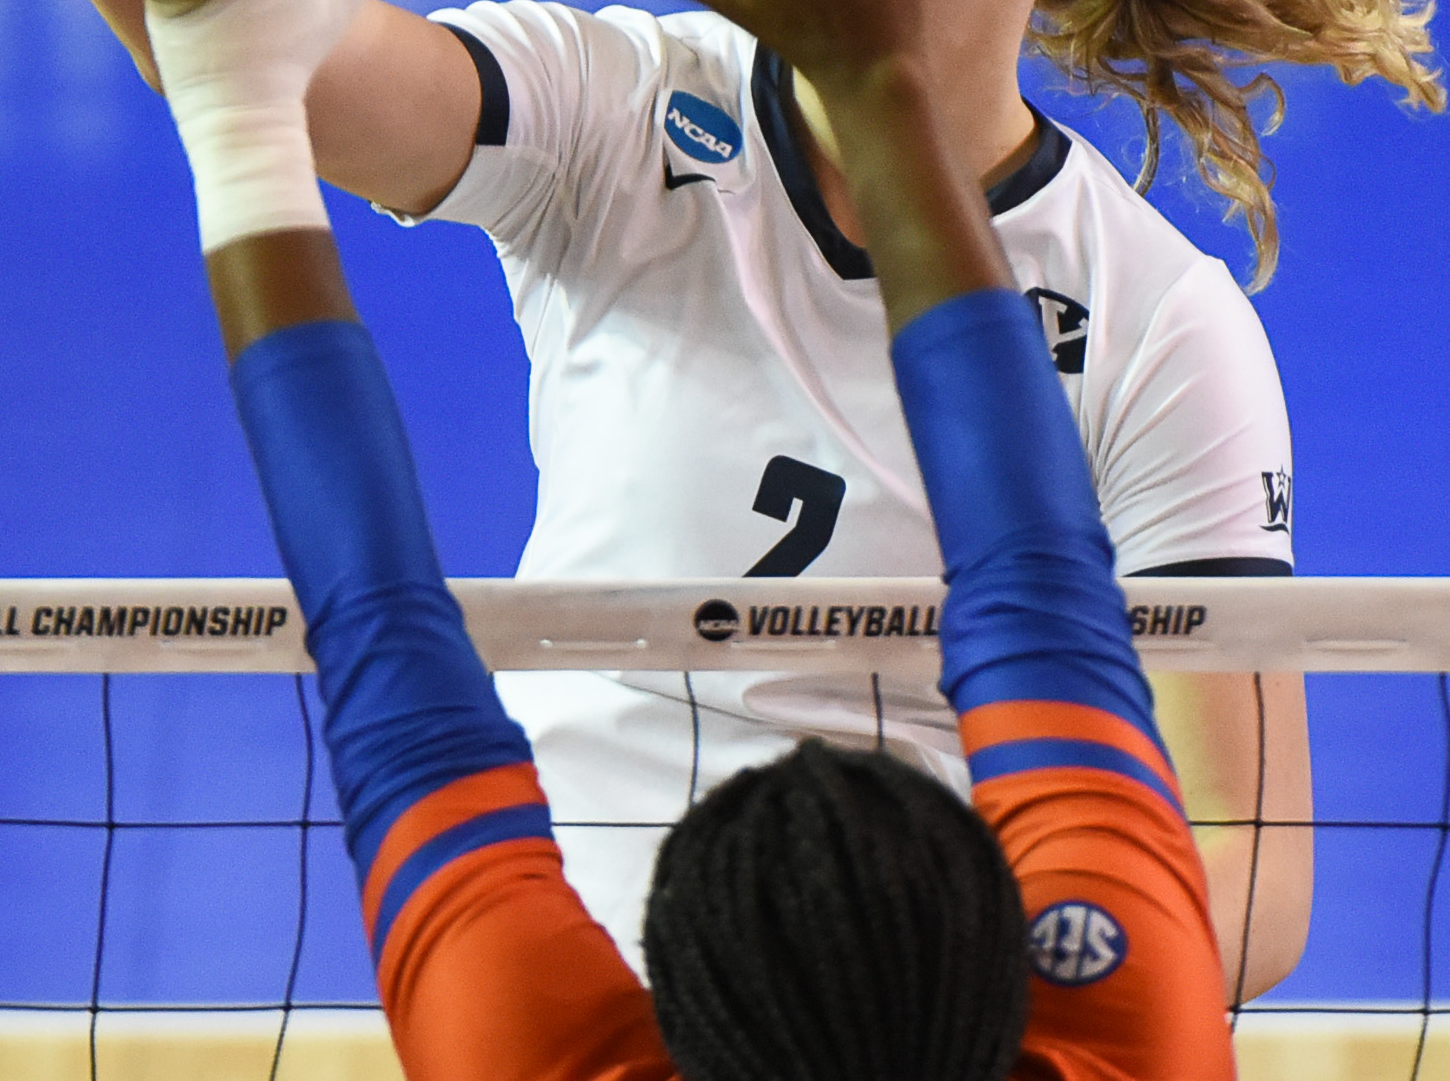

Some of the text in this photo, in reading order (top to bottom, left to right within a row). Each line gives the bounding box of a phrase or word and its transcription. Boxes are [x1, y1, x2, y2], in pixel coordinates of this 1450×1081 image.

[667, 108, 733, 158] NCAA
[741, 454, 847, 578] 2
[30, 605, 288, 637] CHAMPIONSHIP
[748, 605, 940, 637] VOLLEYBALL
[1126, 605, 1207, 636] SHIP
